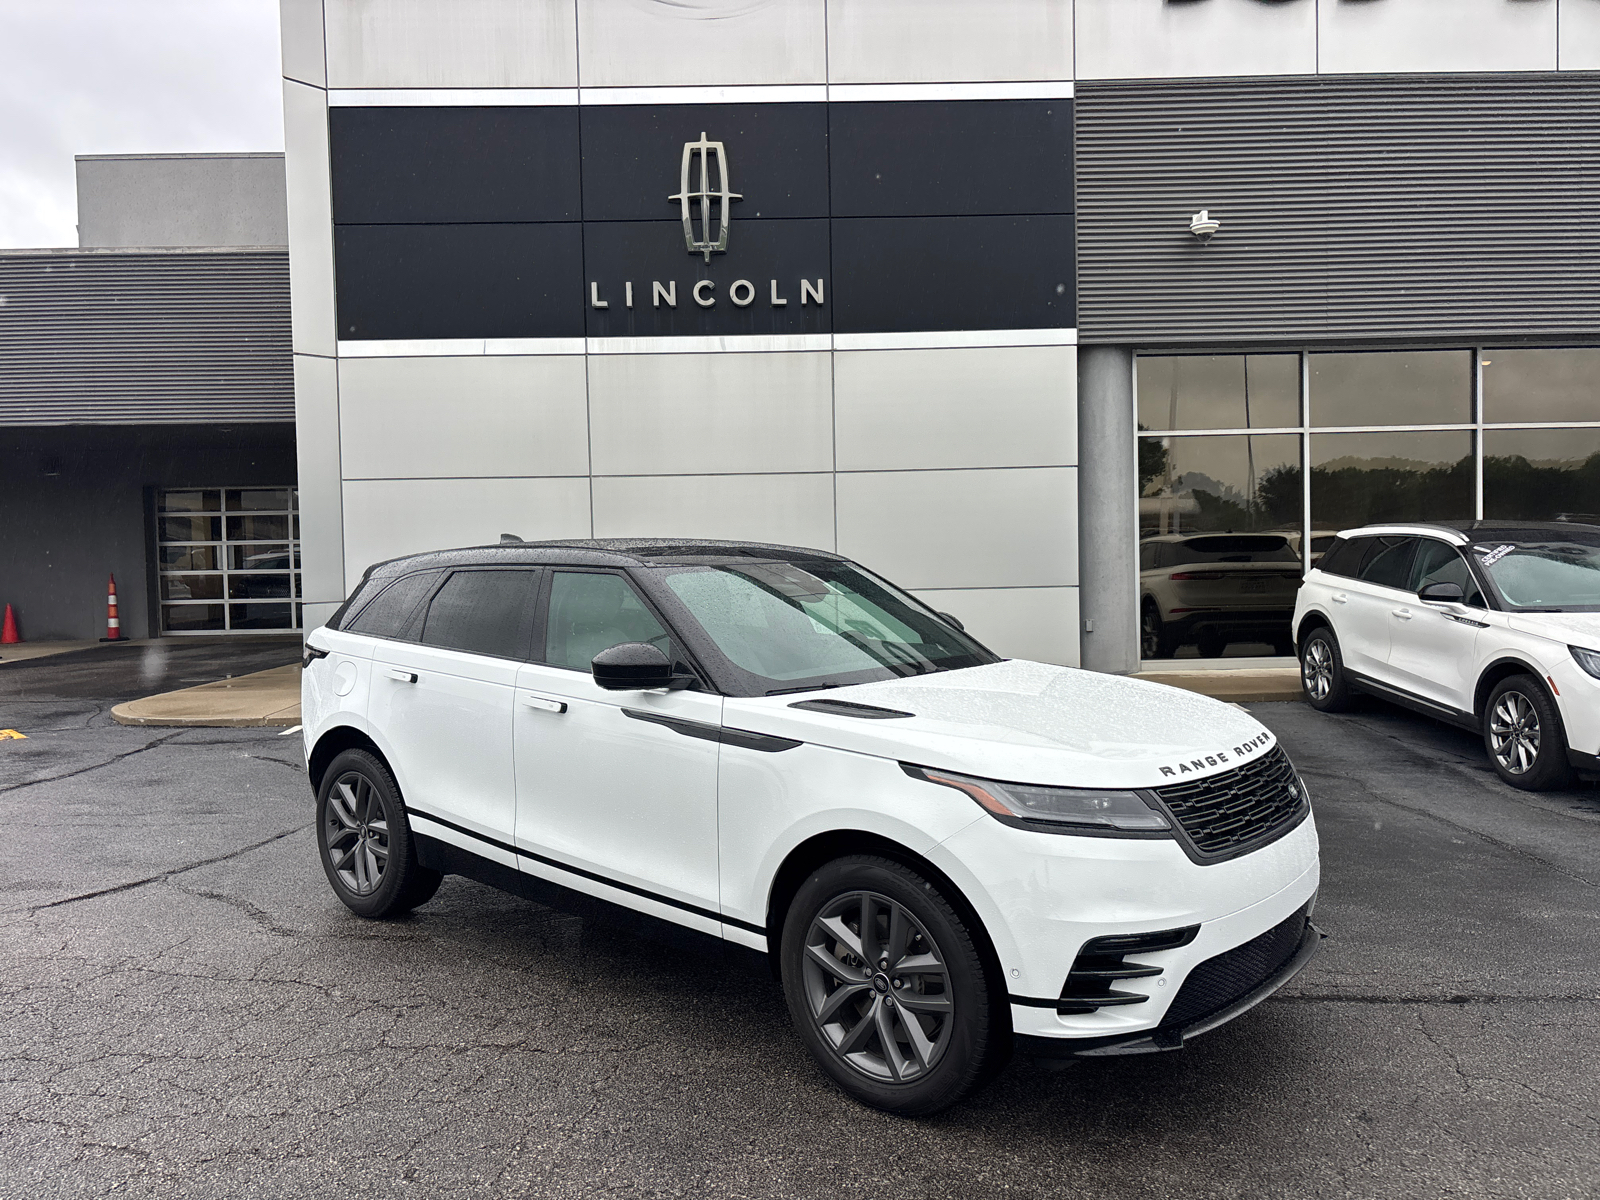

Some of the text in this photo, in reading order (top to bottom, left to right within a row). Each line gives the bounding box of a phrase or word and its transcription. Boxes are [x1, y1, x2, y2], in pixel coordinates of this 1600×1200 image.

[591, 279, 824, 308] LINCOLN
[1158, 732, 1271, 777] RANGE ROVER
